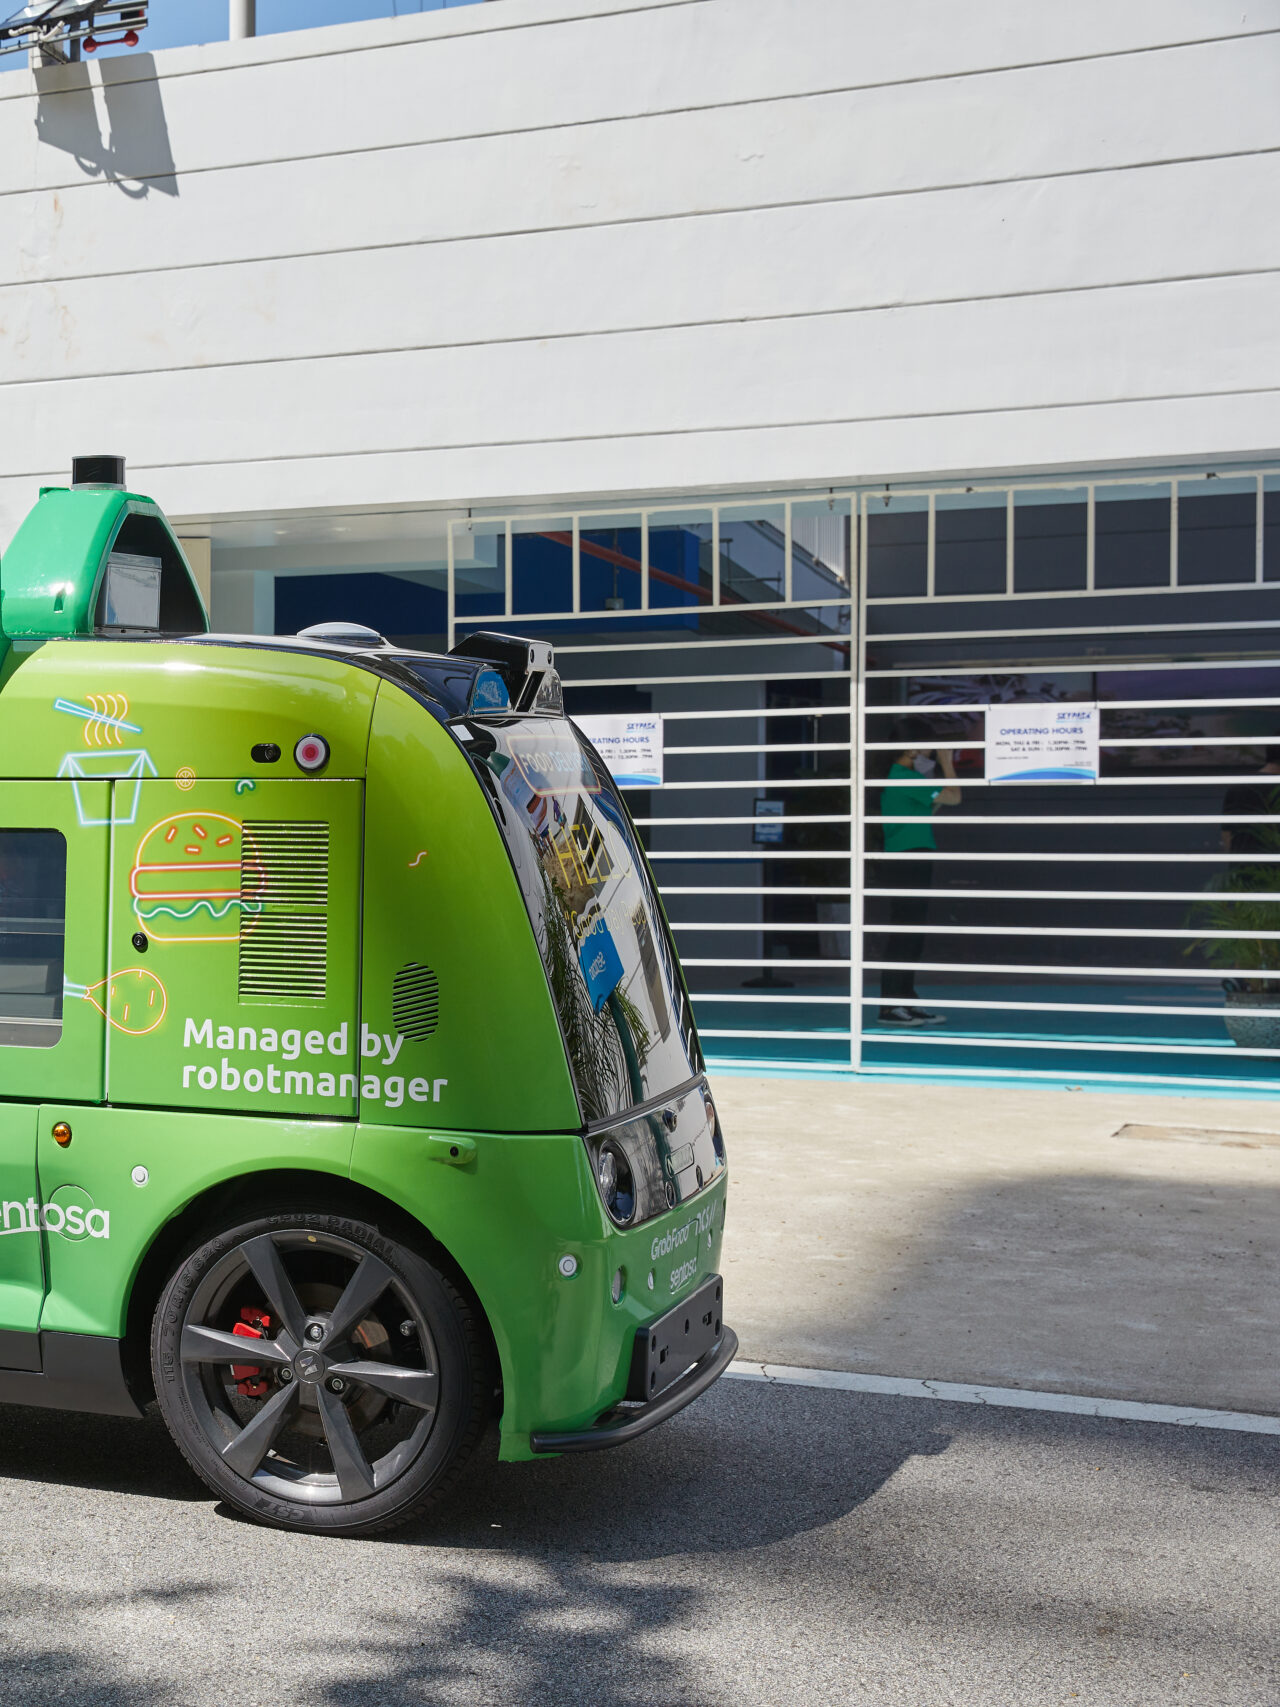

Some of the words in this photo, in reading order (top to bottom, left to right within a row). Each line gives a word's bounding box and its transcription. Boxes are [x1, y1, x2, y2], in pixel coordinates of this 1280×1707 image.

[1000, 728, 1049, 736] OPERATING
[1052, 727, 1084, 735] HOURS
[518, 752, 555, 774] FOOD
[548, 820, 632, 888] HELLO
[183, 1017, 348, 1061] Managed
[360, 1023, 405, 1066] by
[182, 1058, 448, 1108] robotmanager
[651, 1218, 691, 1260] GrabFood
